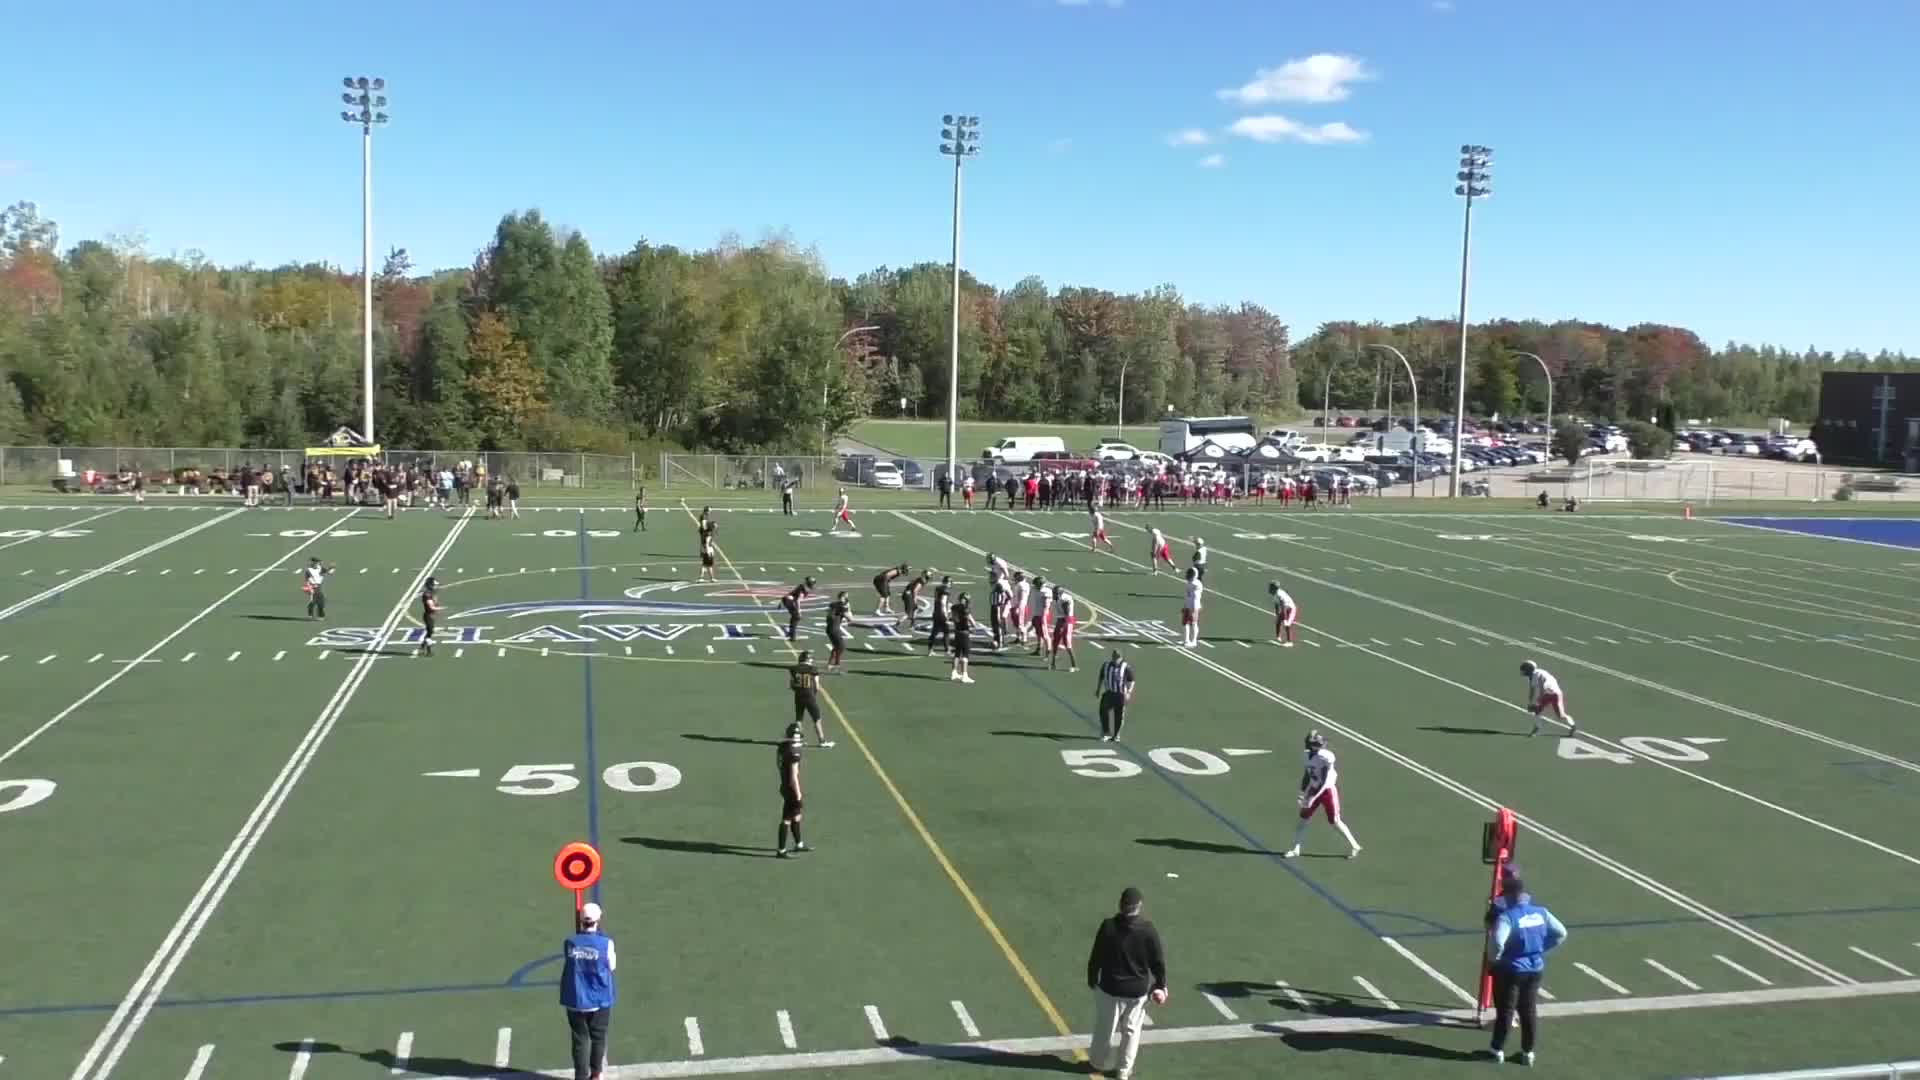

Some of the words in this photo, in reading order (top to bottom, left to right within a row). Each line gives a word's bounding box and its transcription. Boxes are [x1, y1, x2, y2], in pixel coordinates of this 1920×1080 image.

[1059, 747, 1230, 778] 50
[1556, 736, 1710, 765] 40
[495, 762, 682, 796] 50
